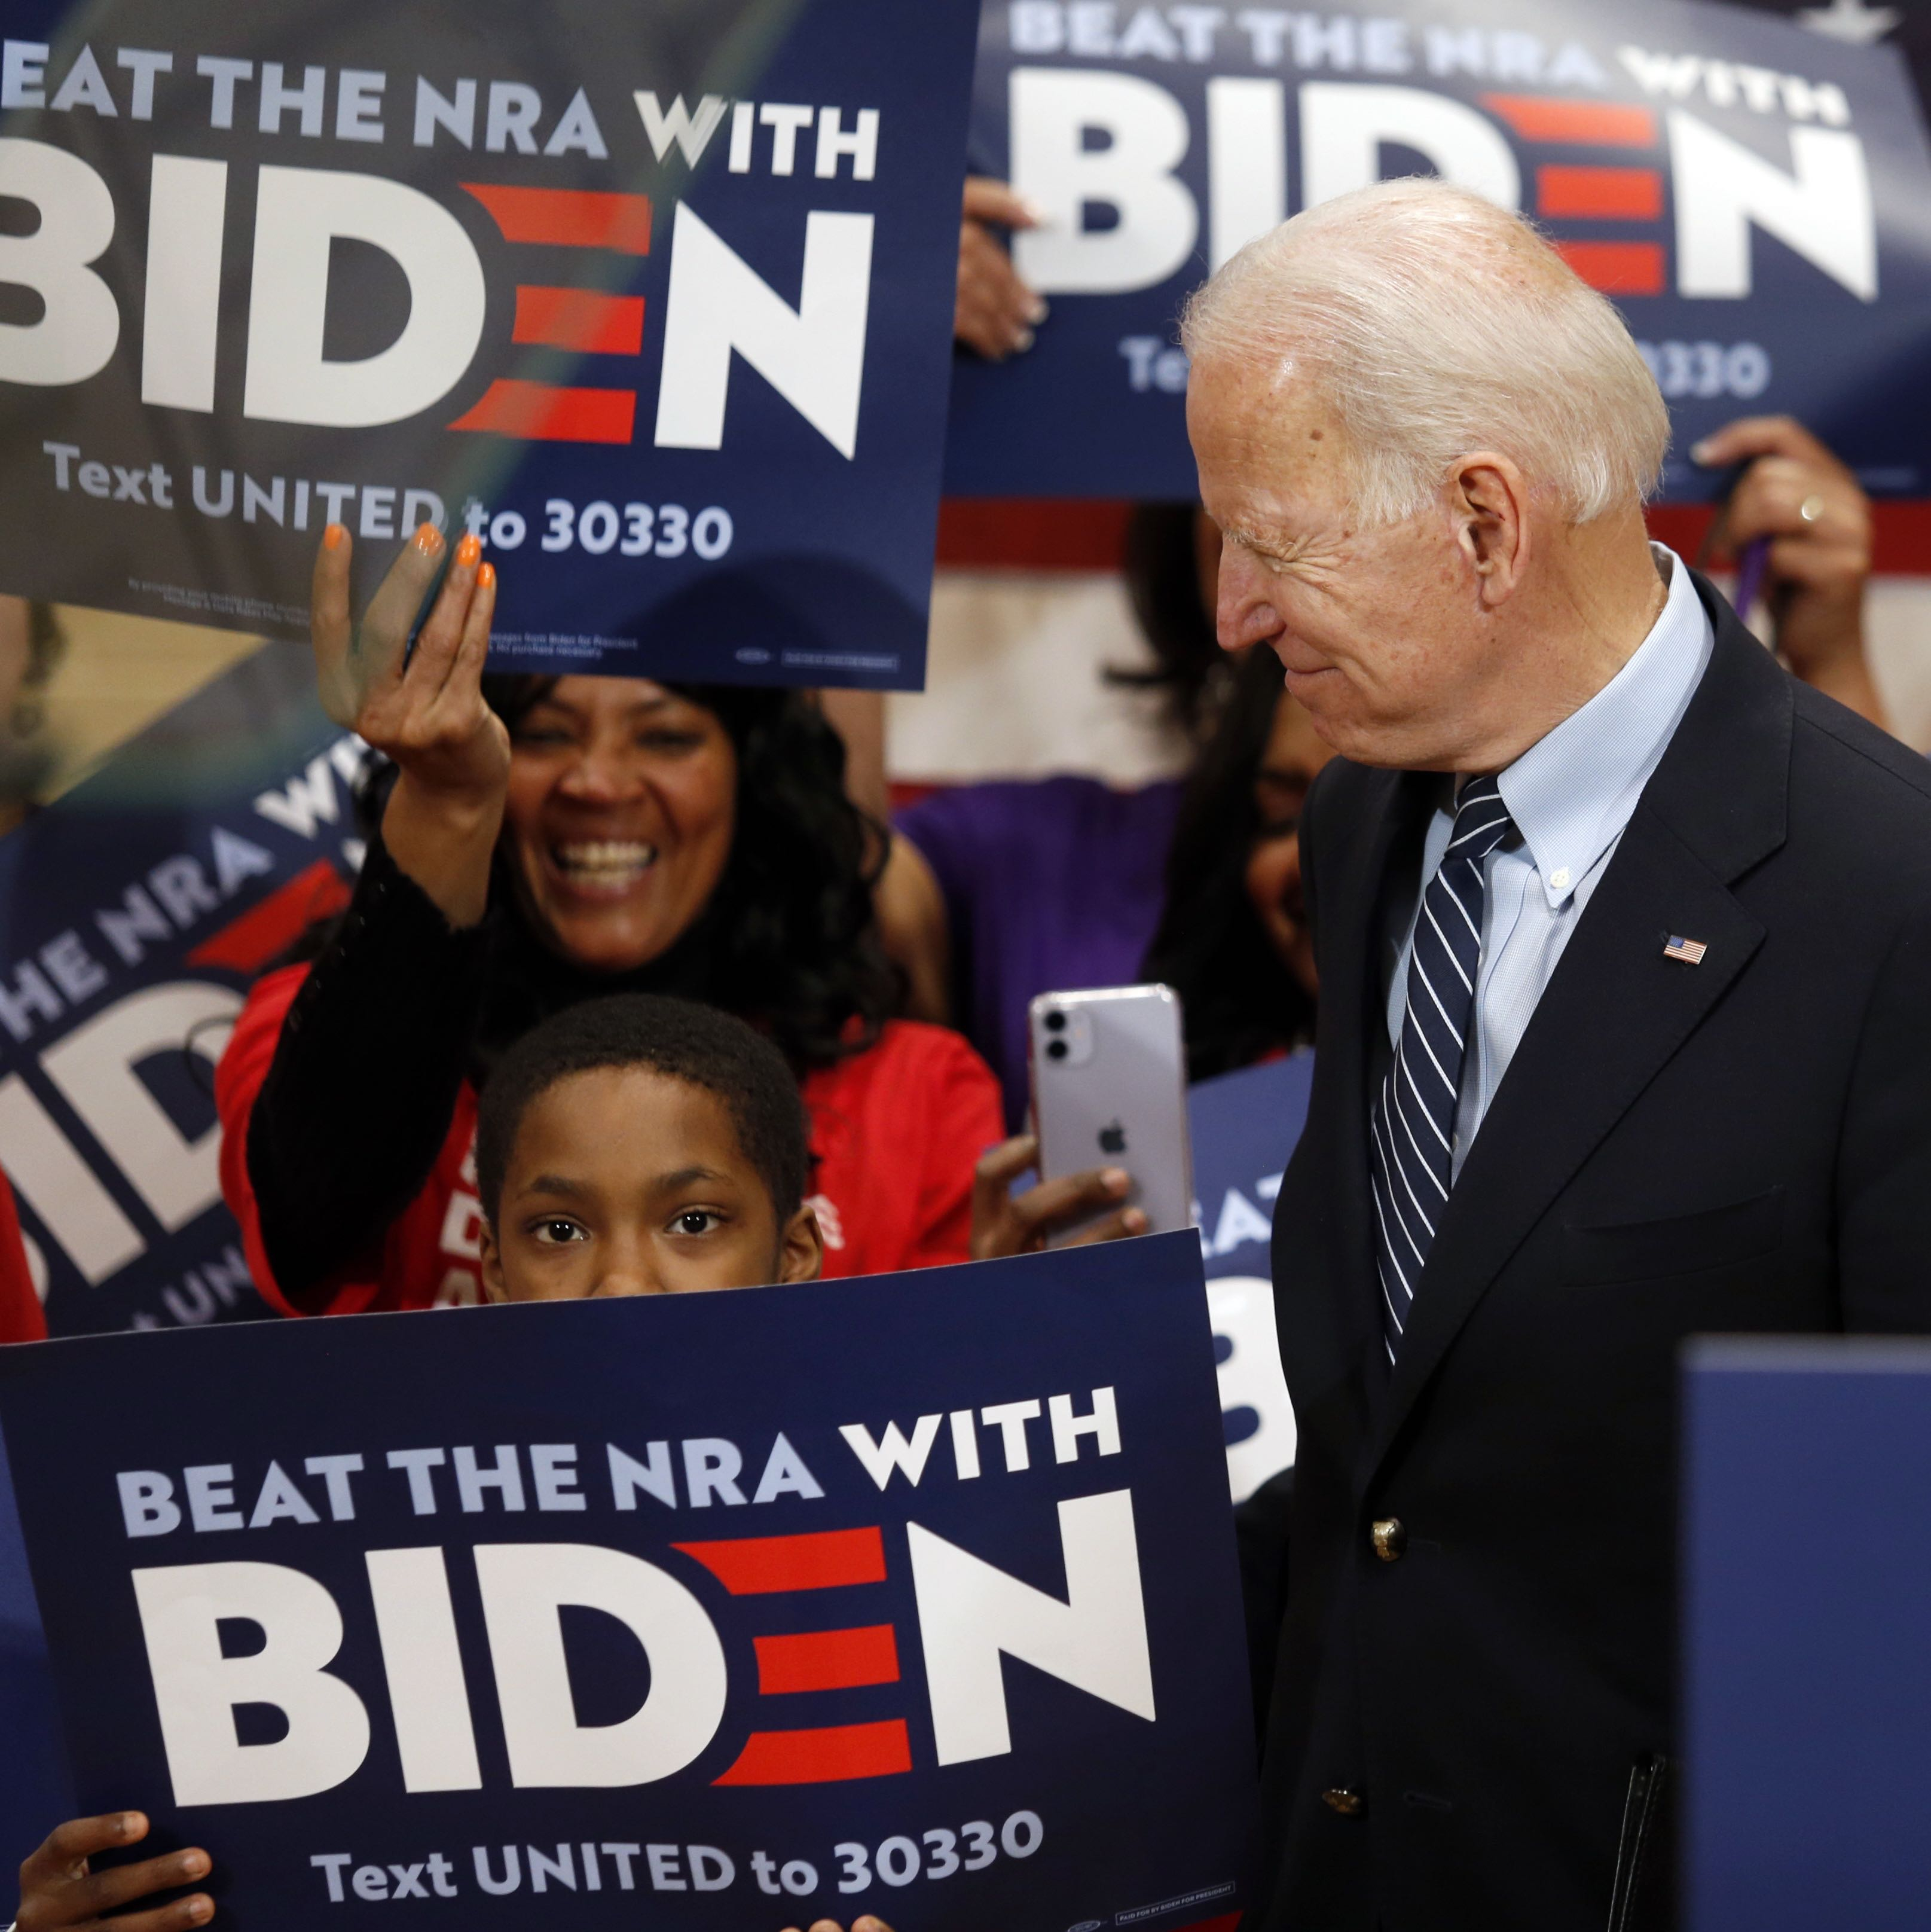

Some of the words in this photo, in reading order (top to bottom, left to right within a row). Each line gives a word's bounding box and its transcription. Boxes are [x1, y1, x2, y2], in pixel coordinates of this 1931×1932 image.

[1, 40, 173, 120] EAT
[197, 56, 386, 143] THE
[413, 75, 608, 159] NRA
[633, 90, 880, 181] WITH
[1009, 0, 1227, 65] BEAT
[1235, 9, 1413, 75] THE
[1423, 25, 1609, 91] NRA
[1614, 42, 1852, 127] WITH
[1009, 66, 1880, 303] BIDEN
[0, 136, 875, 460] BIDEN
[1117, 334, 1190, 394] Te
[1636, 340, 1771, 399] 330
[43, 442, 173, 510] Text
[193, 465, 449, 541] UNITED
[462, 496, 527, 550] to
[541, 499, 734, 561] 30330
[0, 928, 109, 1044] HE
[93, 824, 275, 969] NRA
[117, 1454, 364, 1539] BEAT
[386, 1444, 586, 1516] THE
[606, 1432, 825, 1510] NRA
[838, 1385, 1122, 1492] WITH
[131, 1488, 1156, 1808] BIDEN
[310, 1852, 458, 1903] Text
[472, 1842, 735, 1896] UNITED
[750, 1851, 819, 1896] to
[833, 1810, 1044, 1894] 30330
[1119, 1913, 1136, 1922] PAID
[1136, 1909, 1150, 1918] FOR
[1160, 1900, 1181, 1911] BIDEN
[1181, 1896, 1195, 1904] FOR
[1196, 1885, 1232, 1900] PRESIDENT
